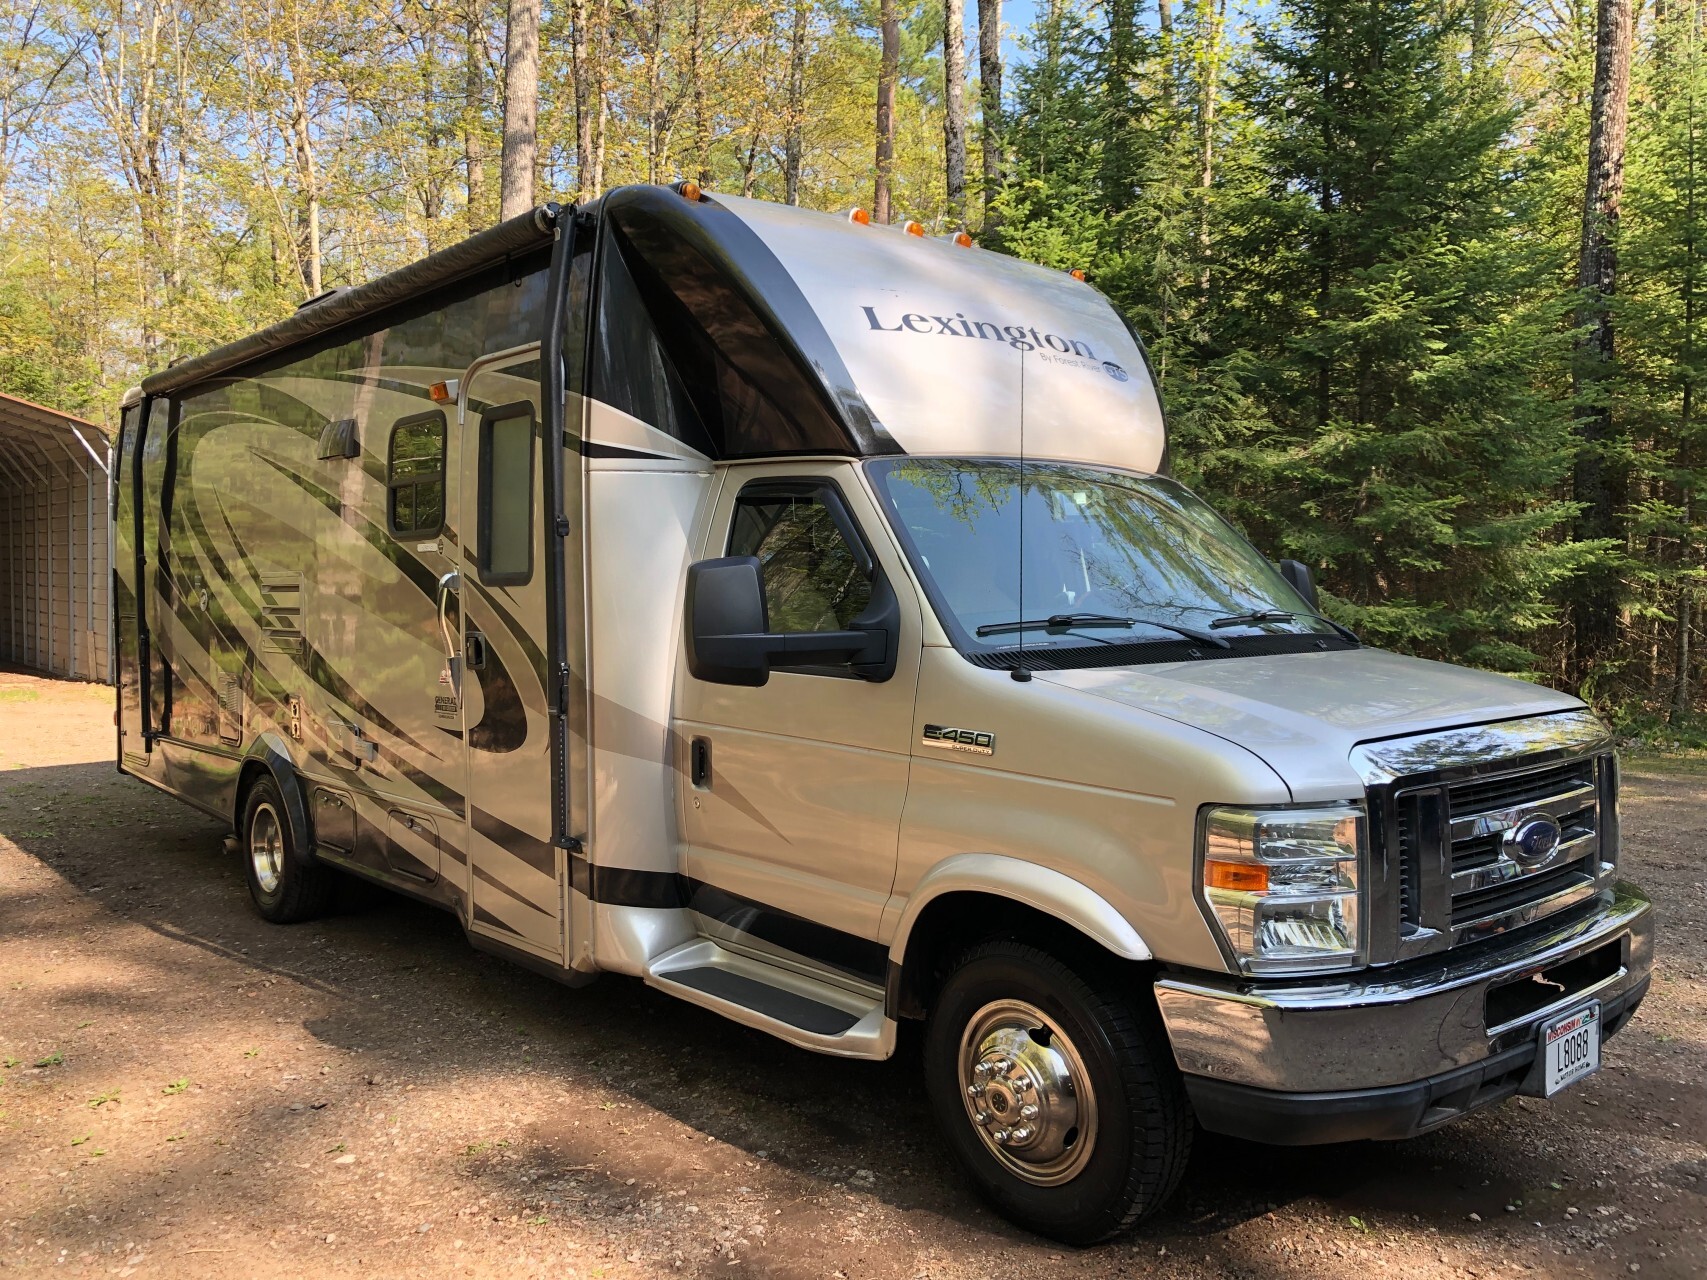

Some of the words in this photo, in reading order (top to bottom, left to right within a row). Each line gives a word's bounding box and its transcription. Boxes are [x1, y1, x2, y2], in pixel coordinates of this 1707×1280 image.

[860, 305, 1098, 361] Lexington
[1040, 352, 1052, 364] By
[1053, 355, 1079, 368] Forest
[1548, 1018, 1576, 1042] WISCONSIN
[1557, 1029, 1589, 1073] L8088
